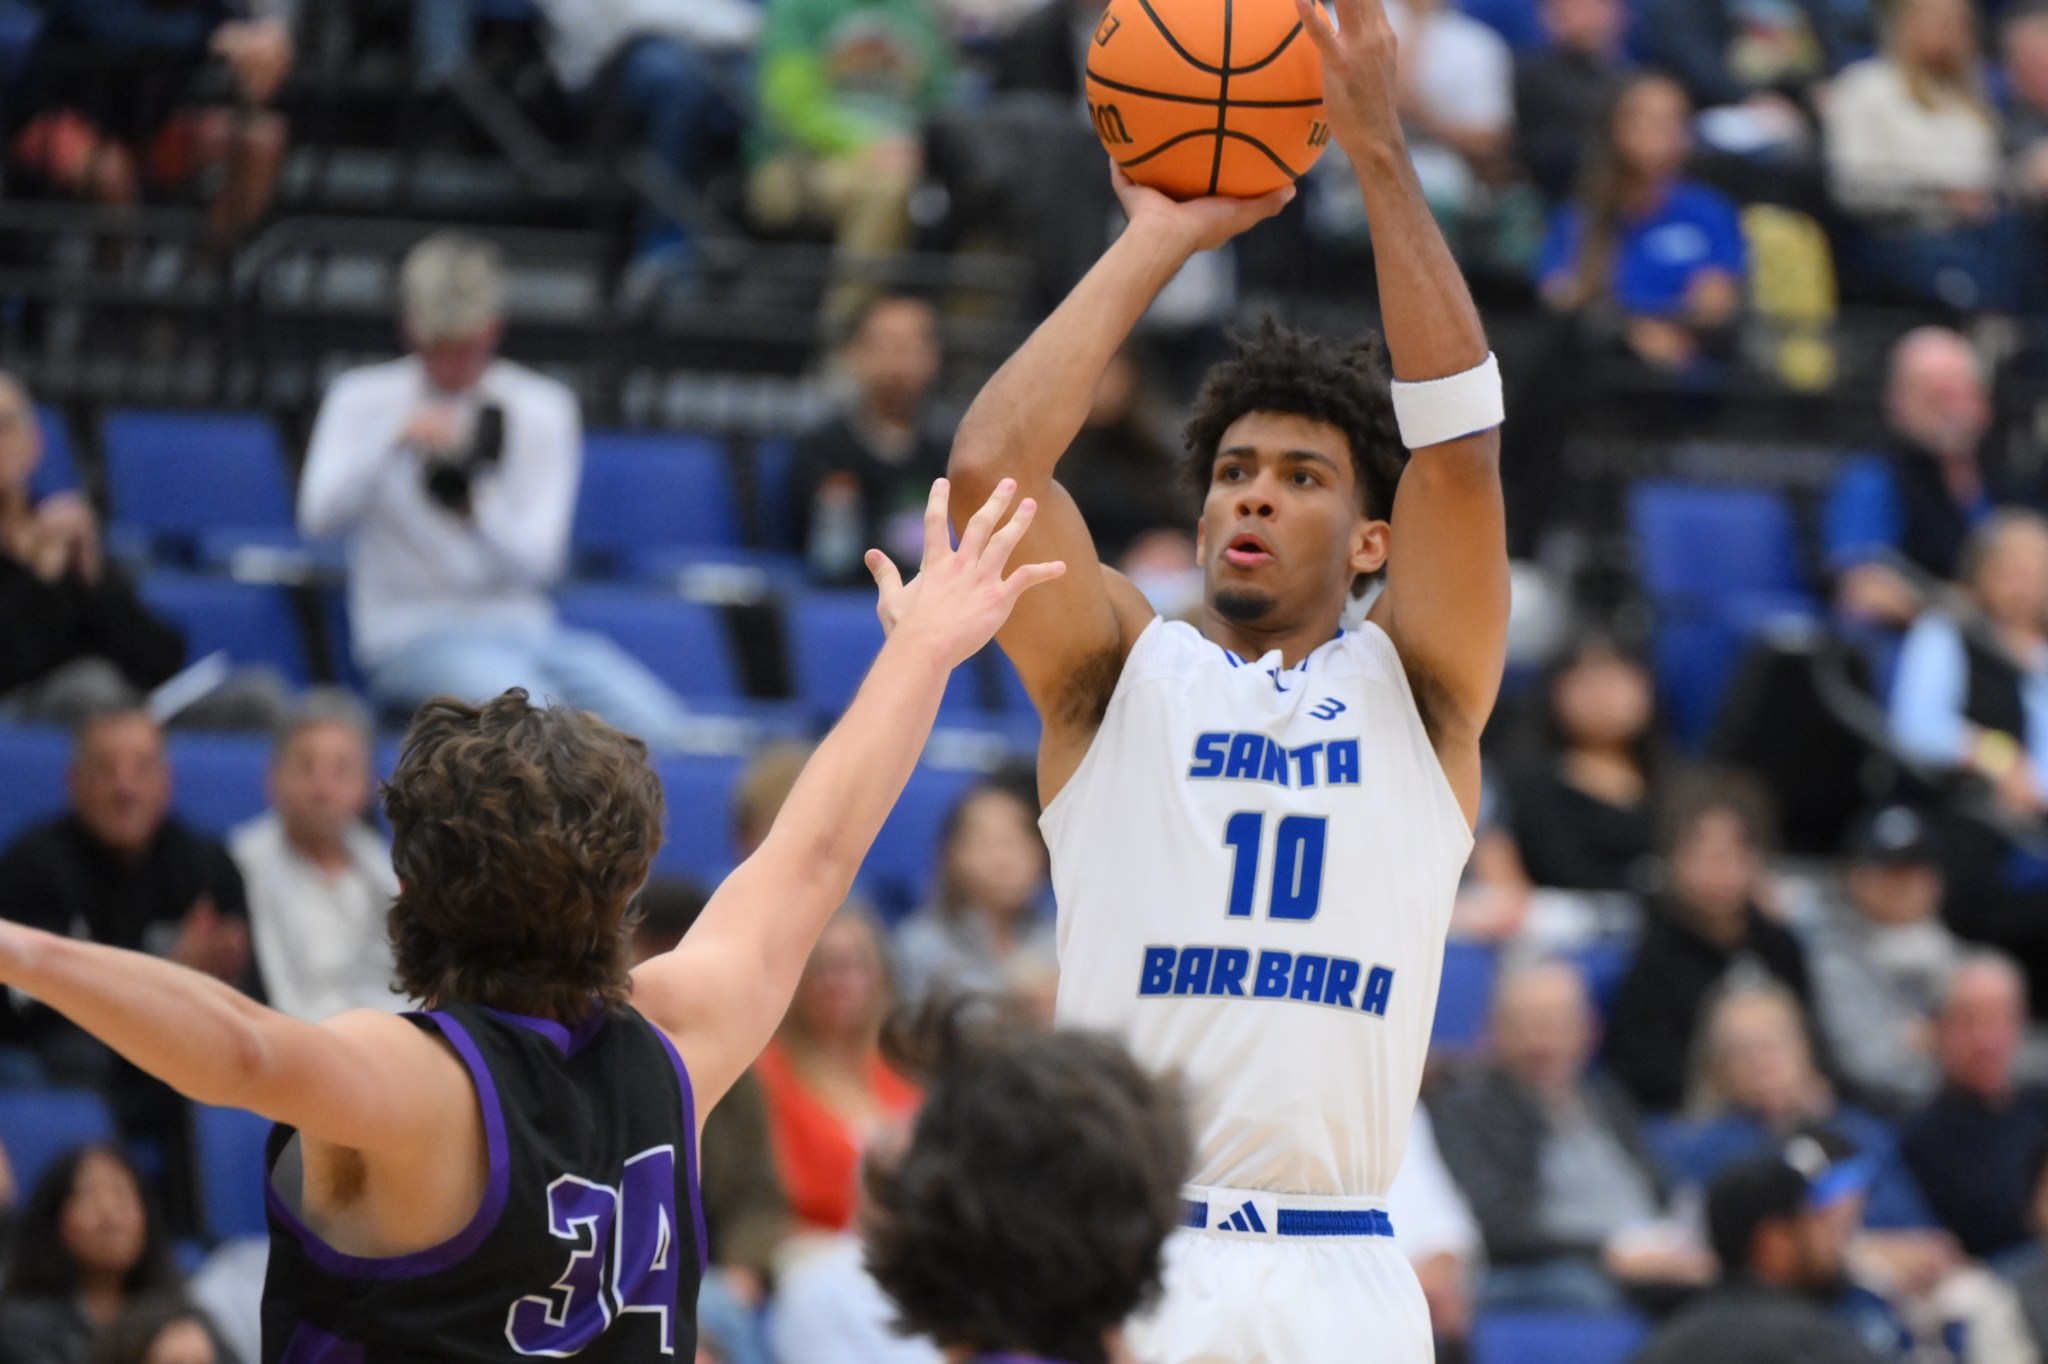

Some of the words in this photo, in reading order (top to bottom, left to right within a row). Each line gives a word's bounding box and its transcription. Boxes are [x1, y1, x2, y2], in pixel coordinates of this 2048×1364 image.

[1187, 730, 1361, 791] SANTA
[1221, 809, 1330, 924] 10
[1136, 943, 1397, 1020] BARBARA
[504, 1144, 679, 1358] 34
